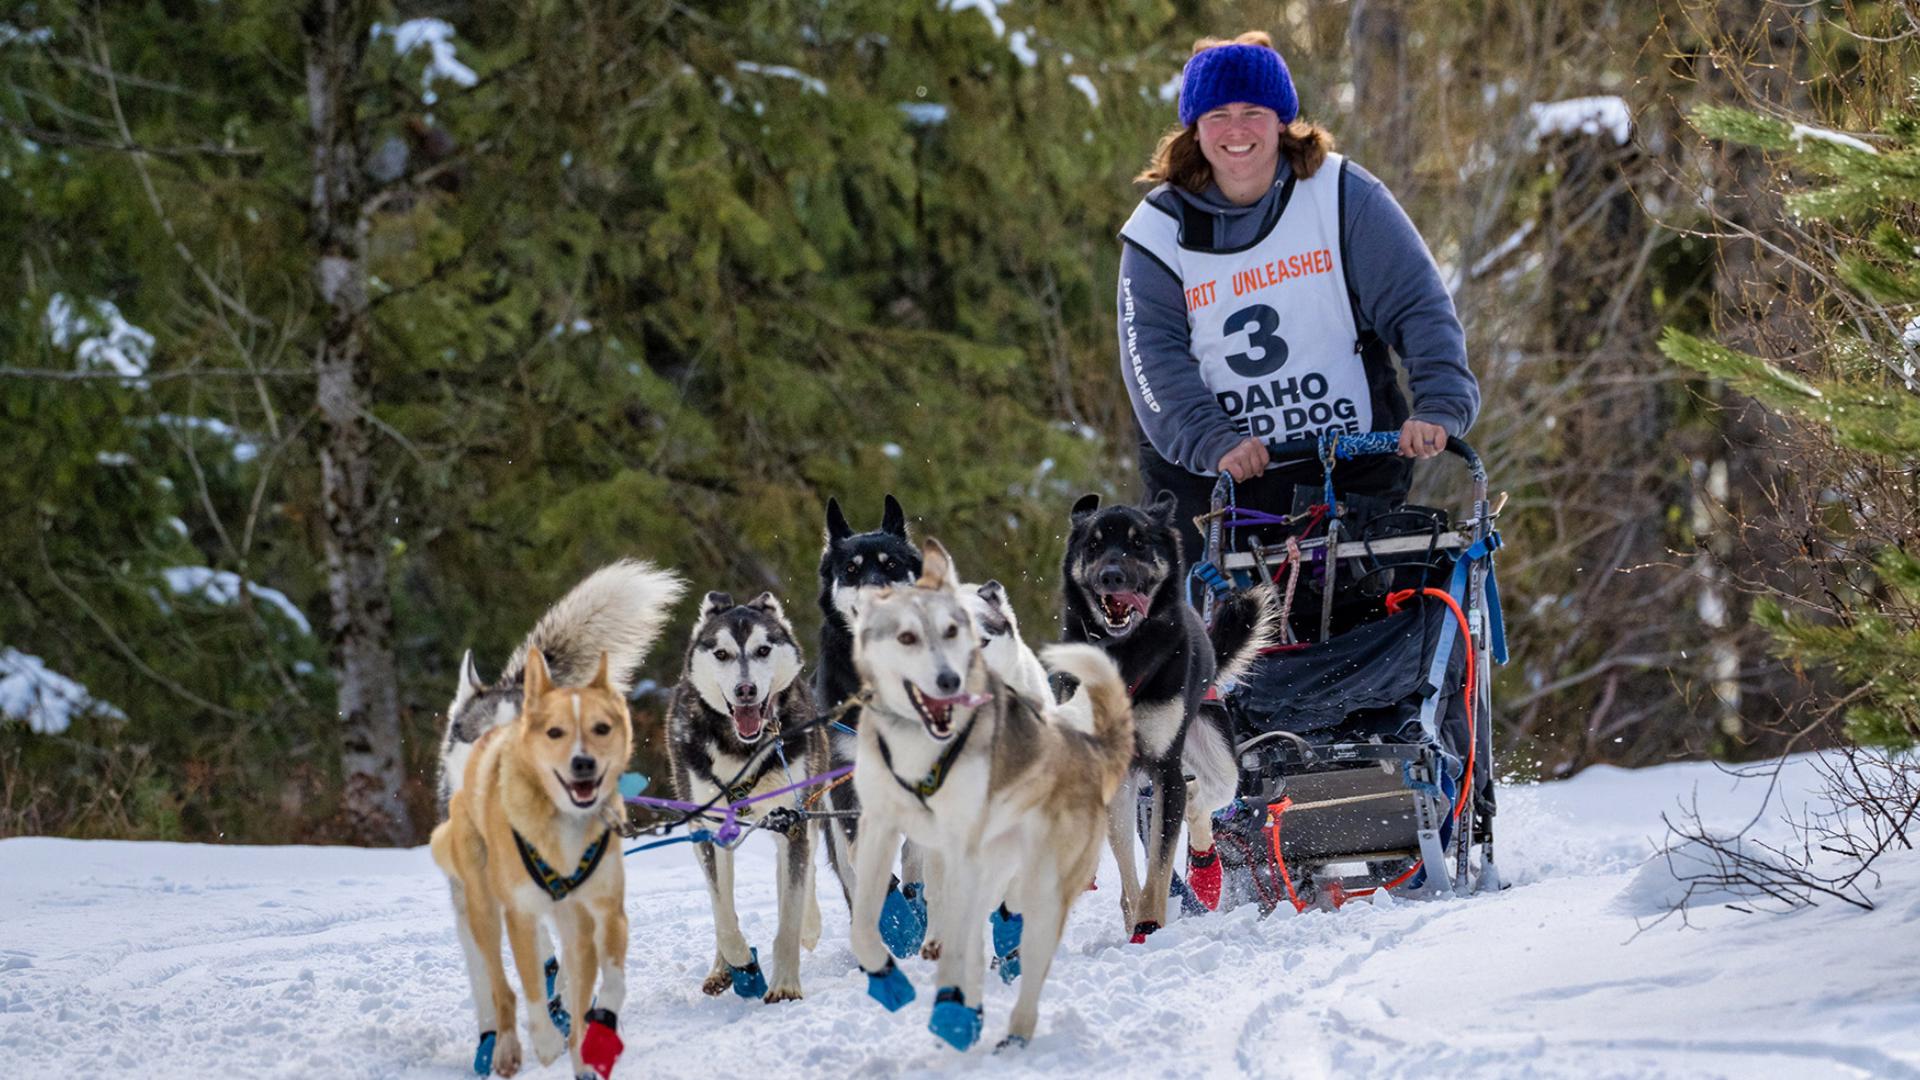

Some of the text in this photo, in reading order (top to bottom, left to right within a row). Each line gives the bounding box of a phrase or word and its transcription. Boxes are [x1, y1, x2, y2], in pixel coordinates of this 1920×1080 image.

[1185, 249, 1333, 312] IRIT UNLEASHED
[1123, 277, 1161, 413] SPIRIT UNLEASHED
[1223, 303, 1289, 378] 3
[1216, 372, 1329, 416] DAHO
[1231, 397, 1358, 437] ED DOG
[1470, 561, 1479, 608] ASTON
